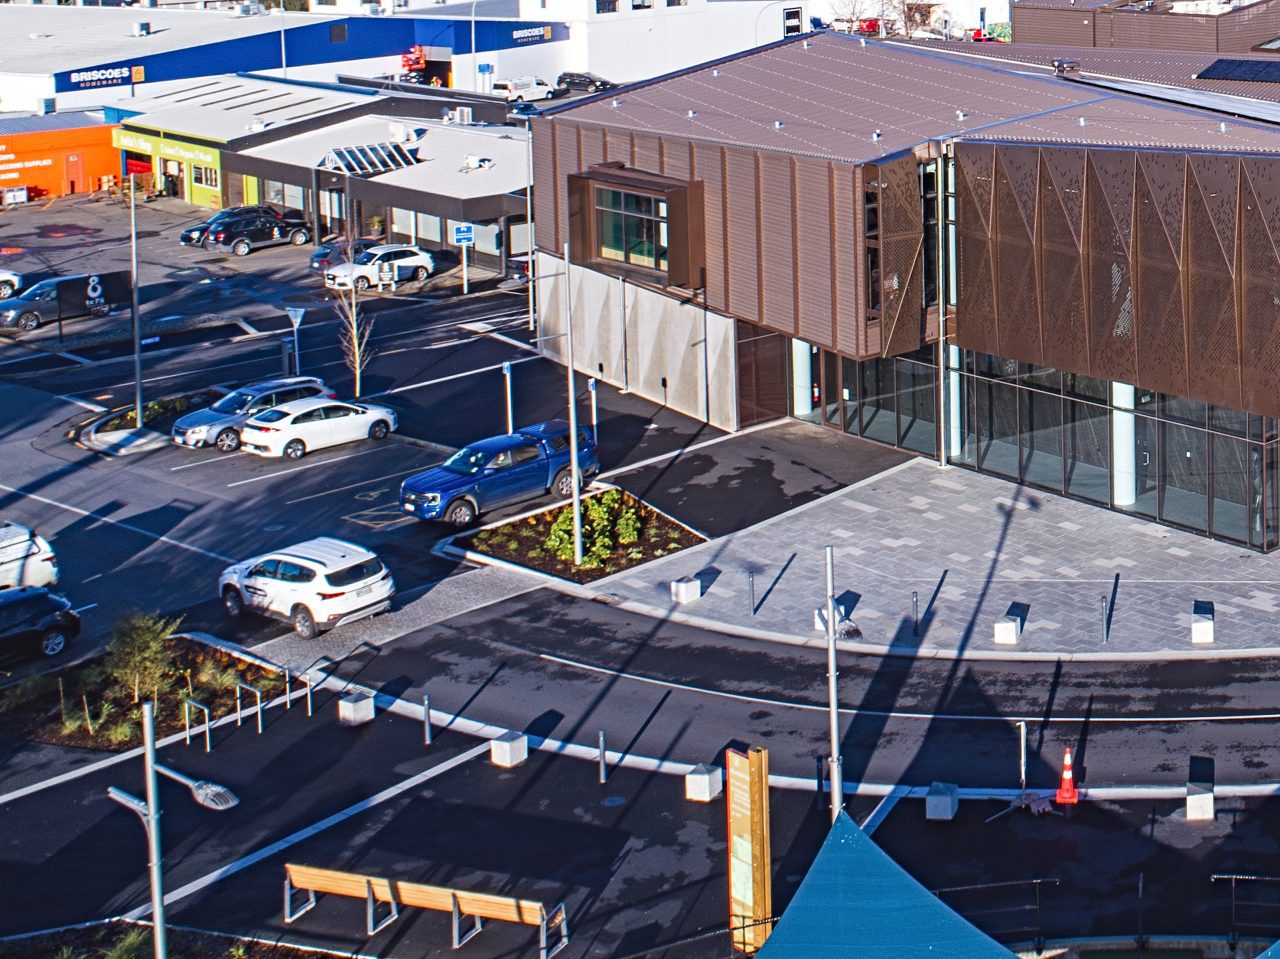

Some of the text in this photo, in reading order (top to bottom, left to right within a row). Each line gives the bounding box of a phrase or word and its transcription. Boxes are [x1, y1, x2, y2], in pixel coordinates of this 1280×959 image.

[512, 27, 544, 39] BRISCOES
[71, 67, 130, 83] BRISCOES
[80, 79, 122, 88] HOMEWARE
